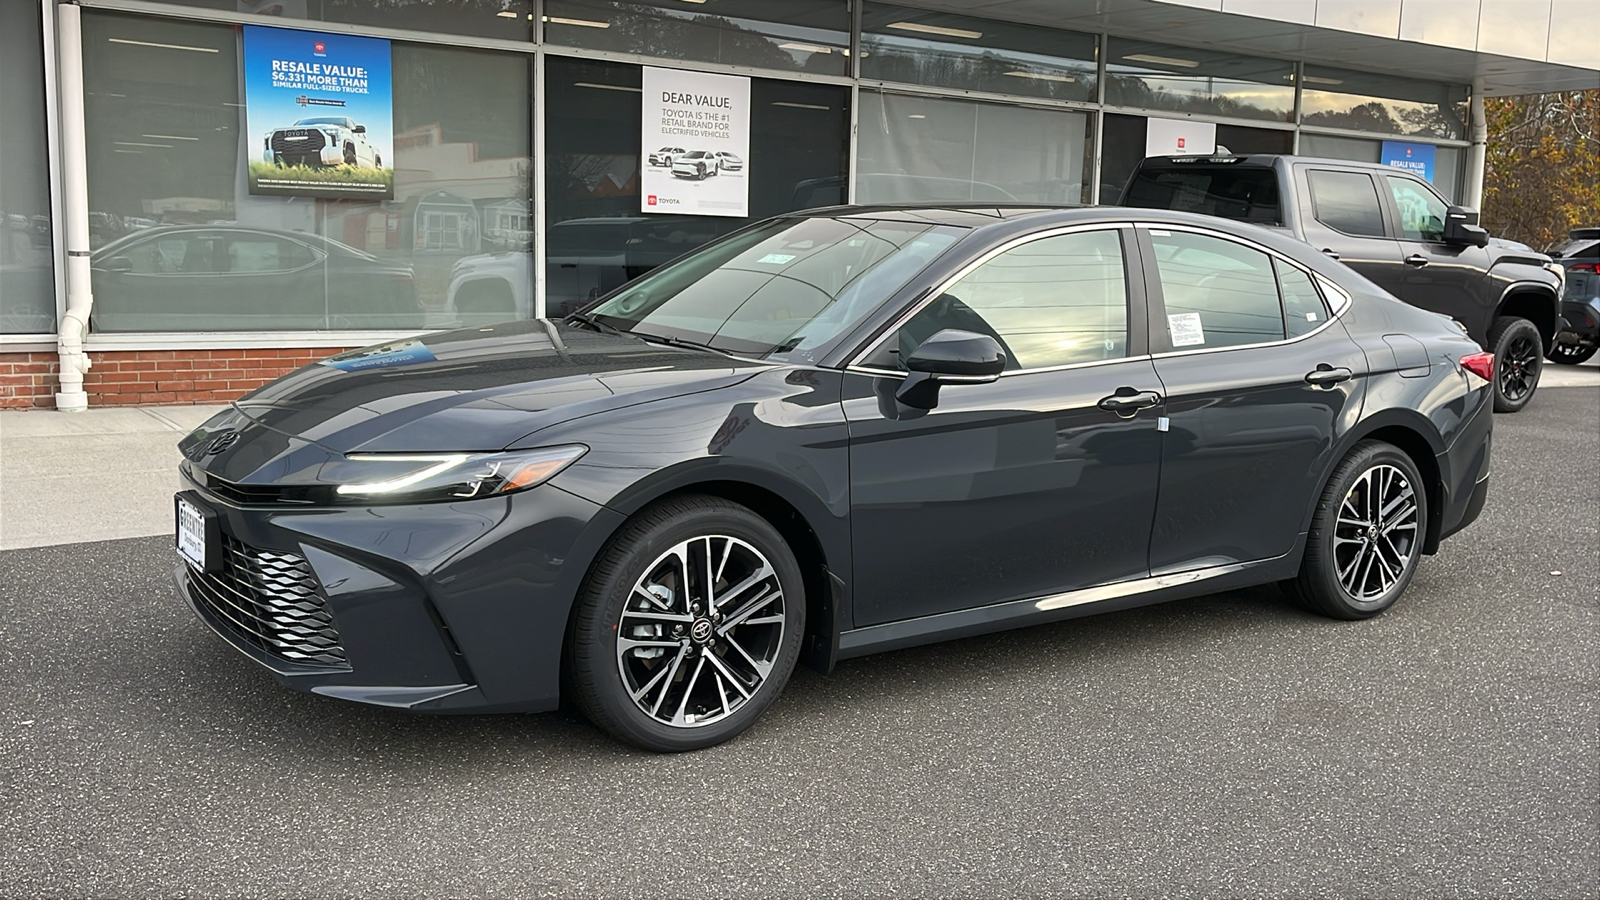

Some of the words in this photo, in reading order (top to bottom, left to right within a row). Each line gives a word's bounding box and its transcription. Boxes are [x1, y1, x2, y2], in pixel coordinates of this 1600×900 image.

[272, 60, 320, 74] RESALE
[322, 64, 368, 79] VALUE:
[272, 71, 305, 82] $6,331
[307, 75, 338, 85] MORE
[339, 78, 368, 88] THAN
[272, 80, 302, 89] SIMILAR
[303, 83, 341, 92] FULL-SIZED
[341, 86, 370, 94] TRUCKS.
[662, 91, 693, 105] DEAR
[694, 94, 733, 110] VALUE,
[662, 108, 694, 119] TOYOTA
[695, 112, 703, 120] IS
[704, 112, 719, 121] THE
[721, 114, 730, 122] #1
[661, 118, 686, 127] RETAIL
[687, 120, 714, 130] BRAND
[714, 122, 729, 131] FOR
[284, 128, 309, 137] TOYOTA
[661, 127, 700, 136] ELECTRIFIED
[700, 130, 730, 139] VEHICLES.
[1390, 160, 1408, 168] RESALE
